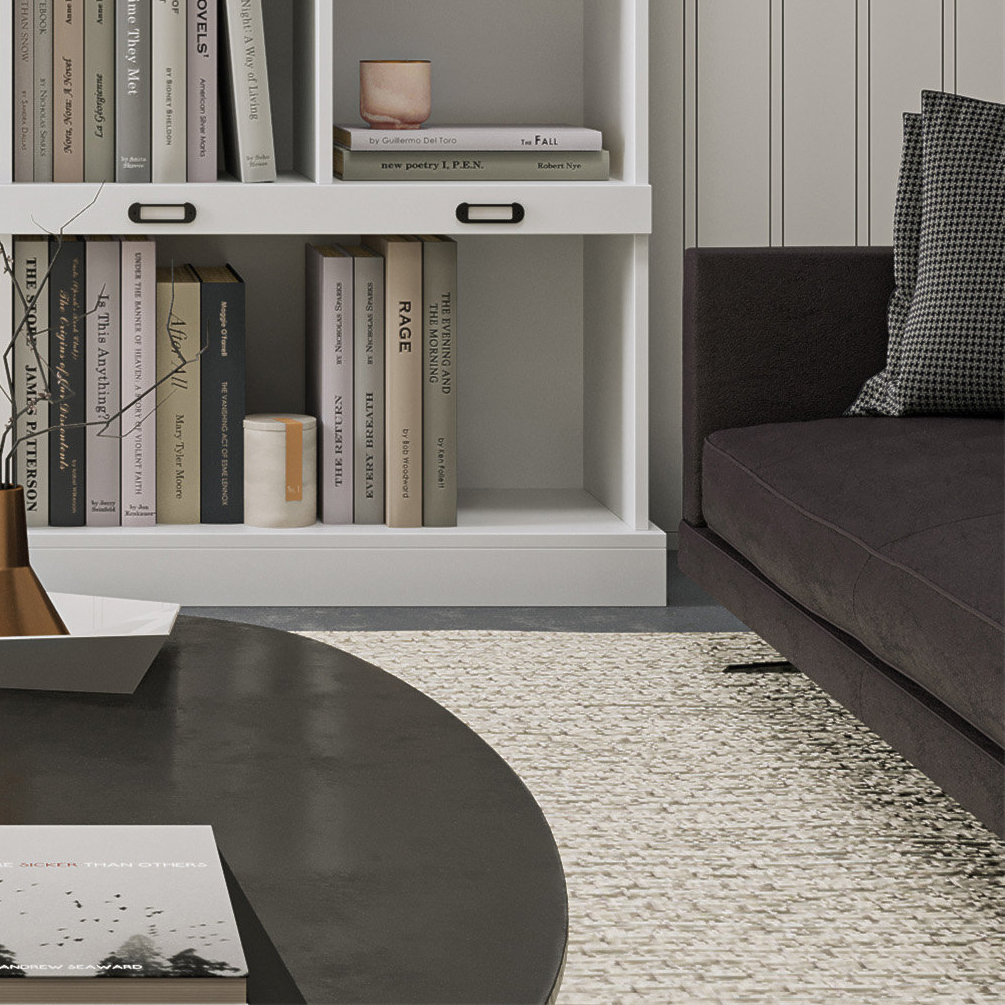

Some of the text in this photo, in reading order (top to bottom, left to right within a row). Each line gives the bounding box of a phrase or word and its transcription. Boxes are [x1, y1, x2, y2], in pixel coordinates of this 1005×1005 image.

[172, 0, 180, 14] OF
[382, 136, 421, 144] Guillermo
[422, 136, 437, 144] Del
[438, 136, 457, 144] Toro
[535, 136, 557, 145] FALL
[381, 162, 402, 170] new
[406, 162, 439, 171] poetry
[452, 161, 483, 171] P.E.N.
[565, 163, 581, 171] Nye
[400, 301, 411, 353] RAGE
[94, 294, 111, 421] Is This Anything?
[25, 364, 39, 513] JAMES PATTERSON
[174, 414, 185, 499] Mary Tyler Moore
